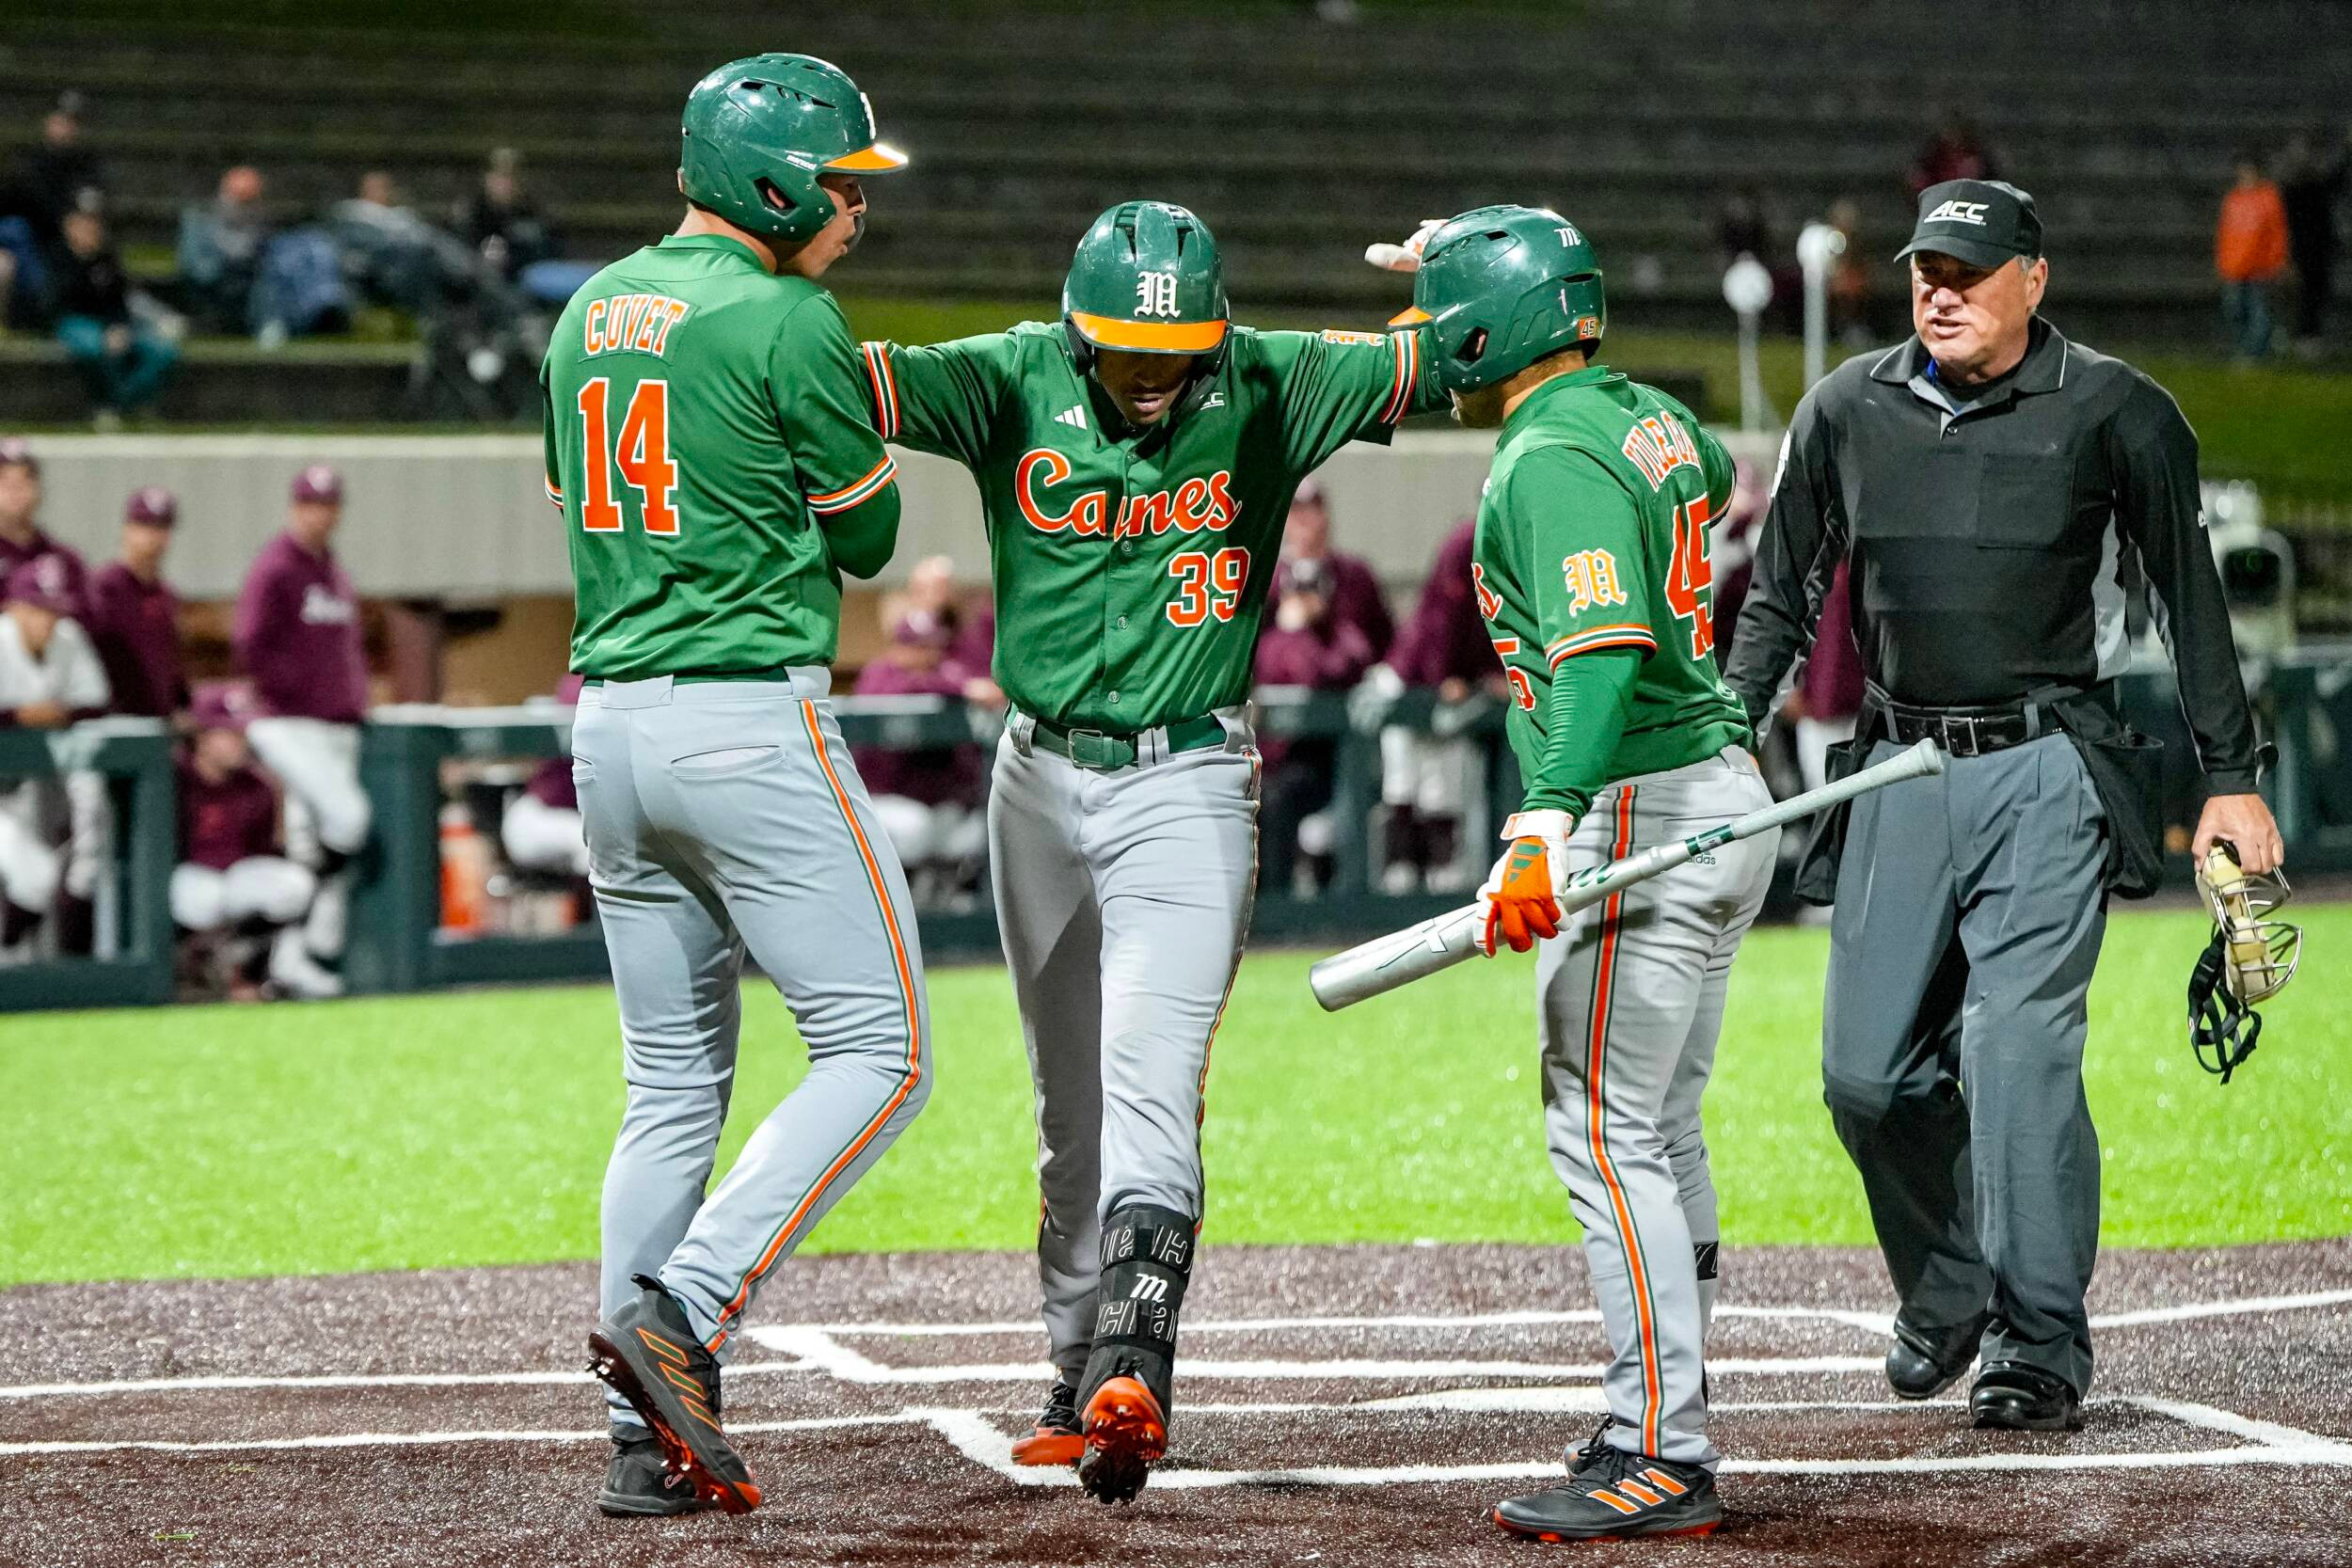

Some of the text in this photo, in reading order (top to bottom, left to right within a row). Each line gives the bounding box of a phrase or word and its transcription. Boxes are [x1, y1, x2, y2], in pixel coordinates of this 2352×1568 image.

[1928, 200, 1990, 221] ACC
[585, 293, 690, 357] CUVET
[1134, 271, 1182, 319] M
[1581, 319, 1597, 338] 45
[578, 376, 680, 536] 14
[1015, 447, 1243, 543] Canes
[1166, 546, 1251, 627] 39
[1562, 547, 1628, 618] M
